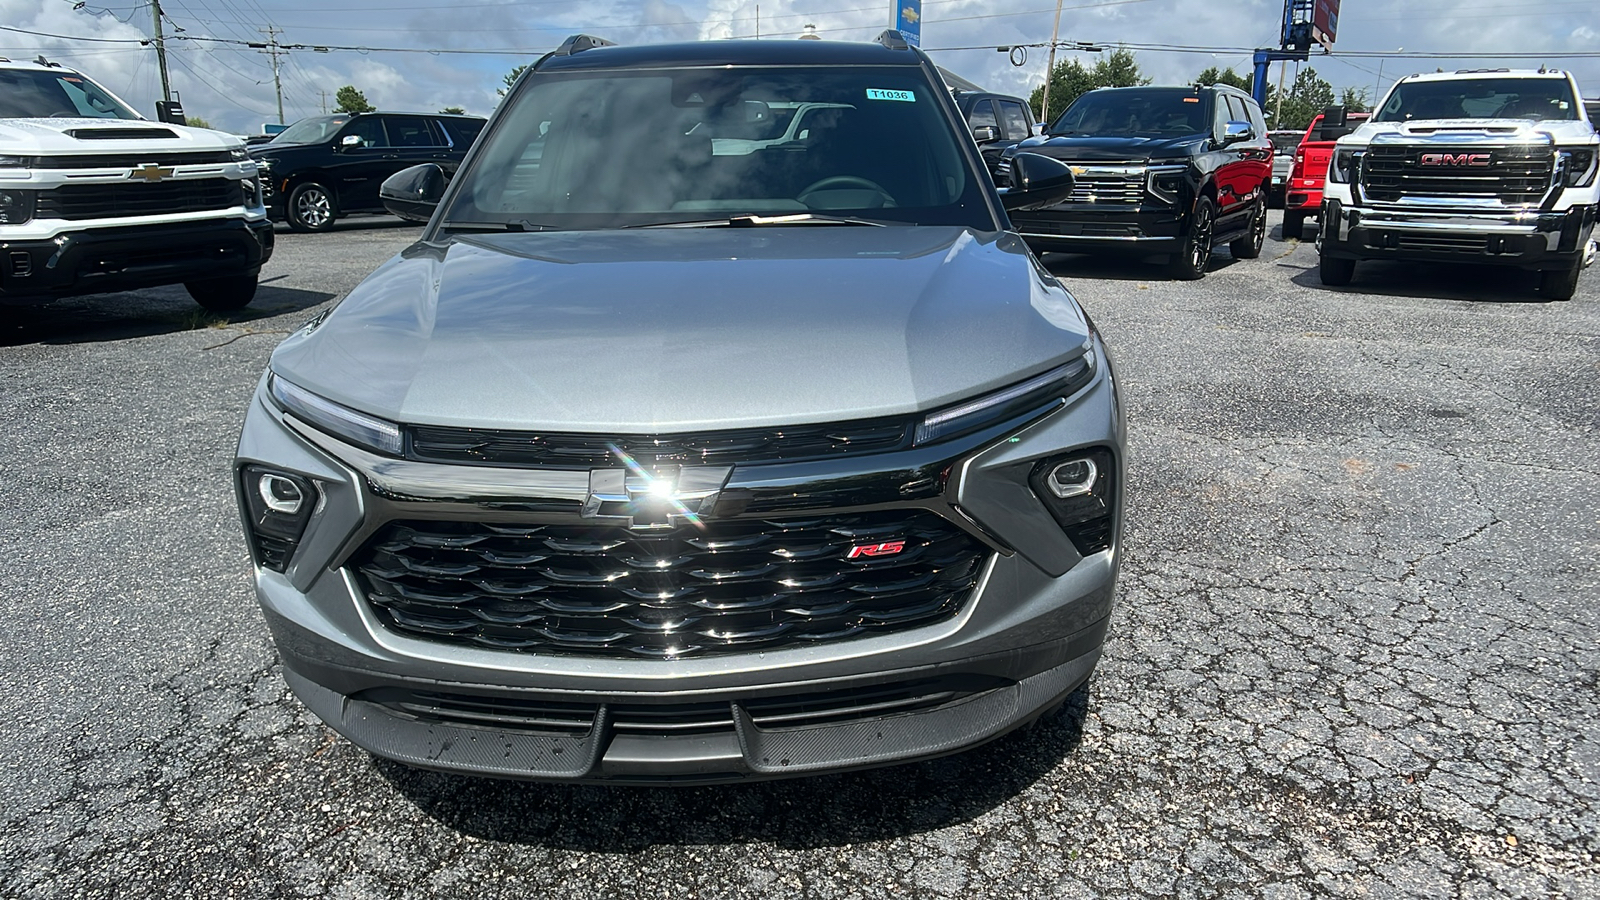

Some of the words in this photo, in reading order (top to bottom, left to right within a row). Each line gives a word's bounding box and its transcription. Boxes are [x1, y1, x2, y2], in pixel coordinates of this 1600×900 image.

[871, 90, 908, 99] T1036
[1421, 153, 1491, 166] GMC
[846, 540, 906, 558] RS
